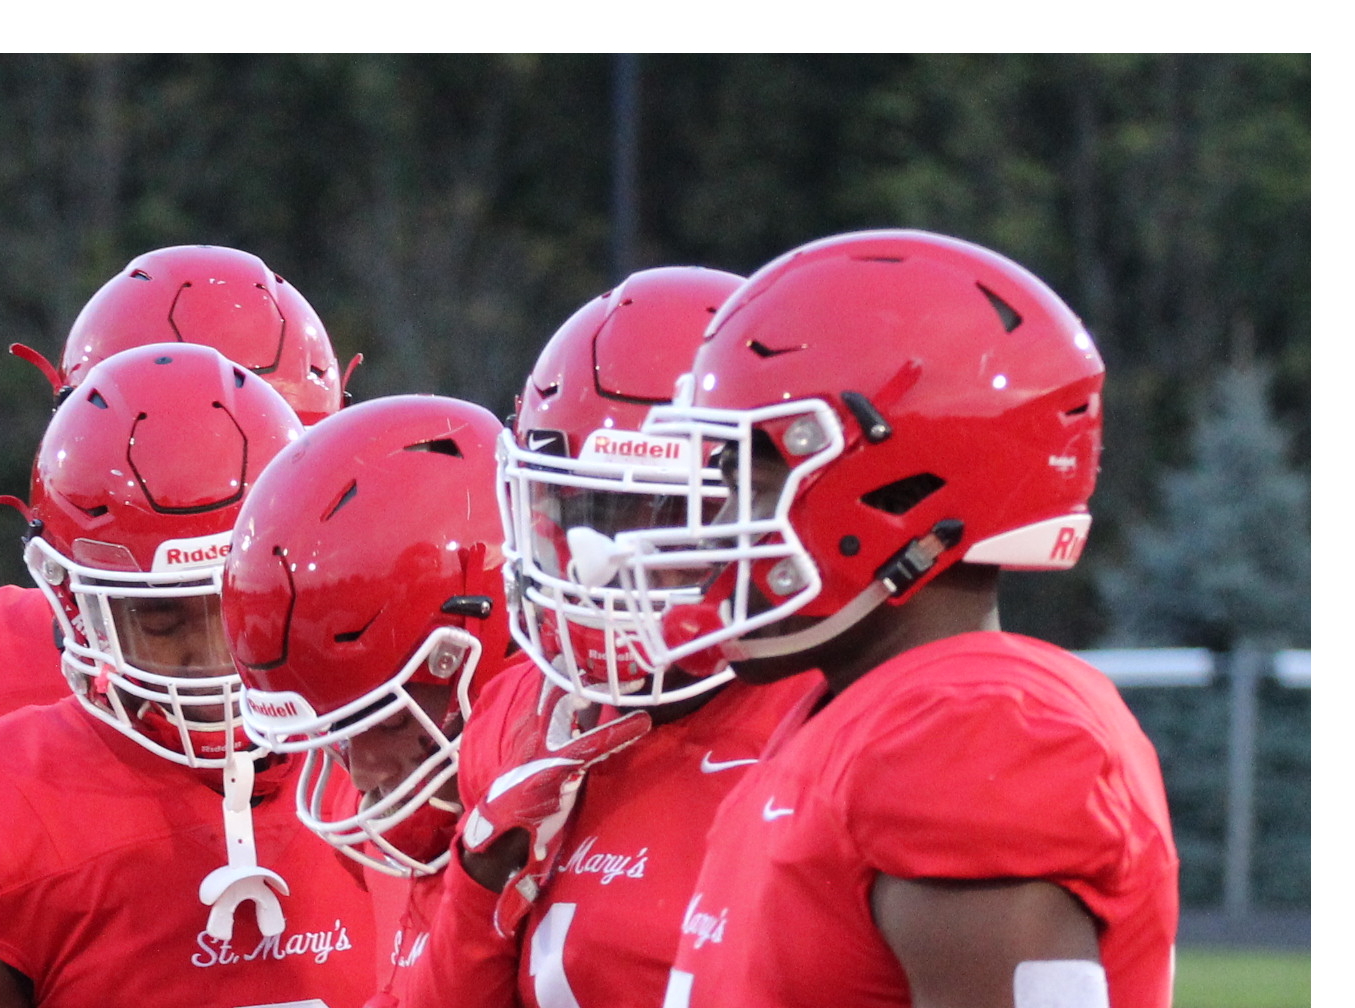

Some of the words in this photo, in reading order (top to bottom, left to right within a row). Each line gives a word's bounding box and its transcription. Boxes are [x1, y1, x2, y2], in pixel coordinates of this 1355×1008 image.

[593, 434, 681, 461] Riddell
[166, 544, 233, 565] Ridde
[248, 700, 298, 718] Riddell
[559, 836, 649, 885] Mary's
[191, 931, 239, 968] St.
[243, 919, 353, 962] Mary's
